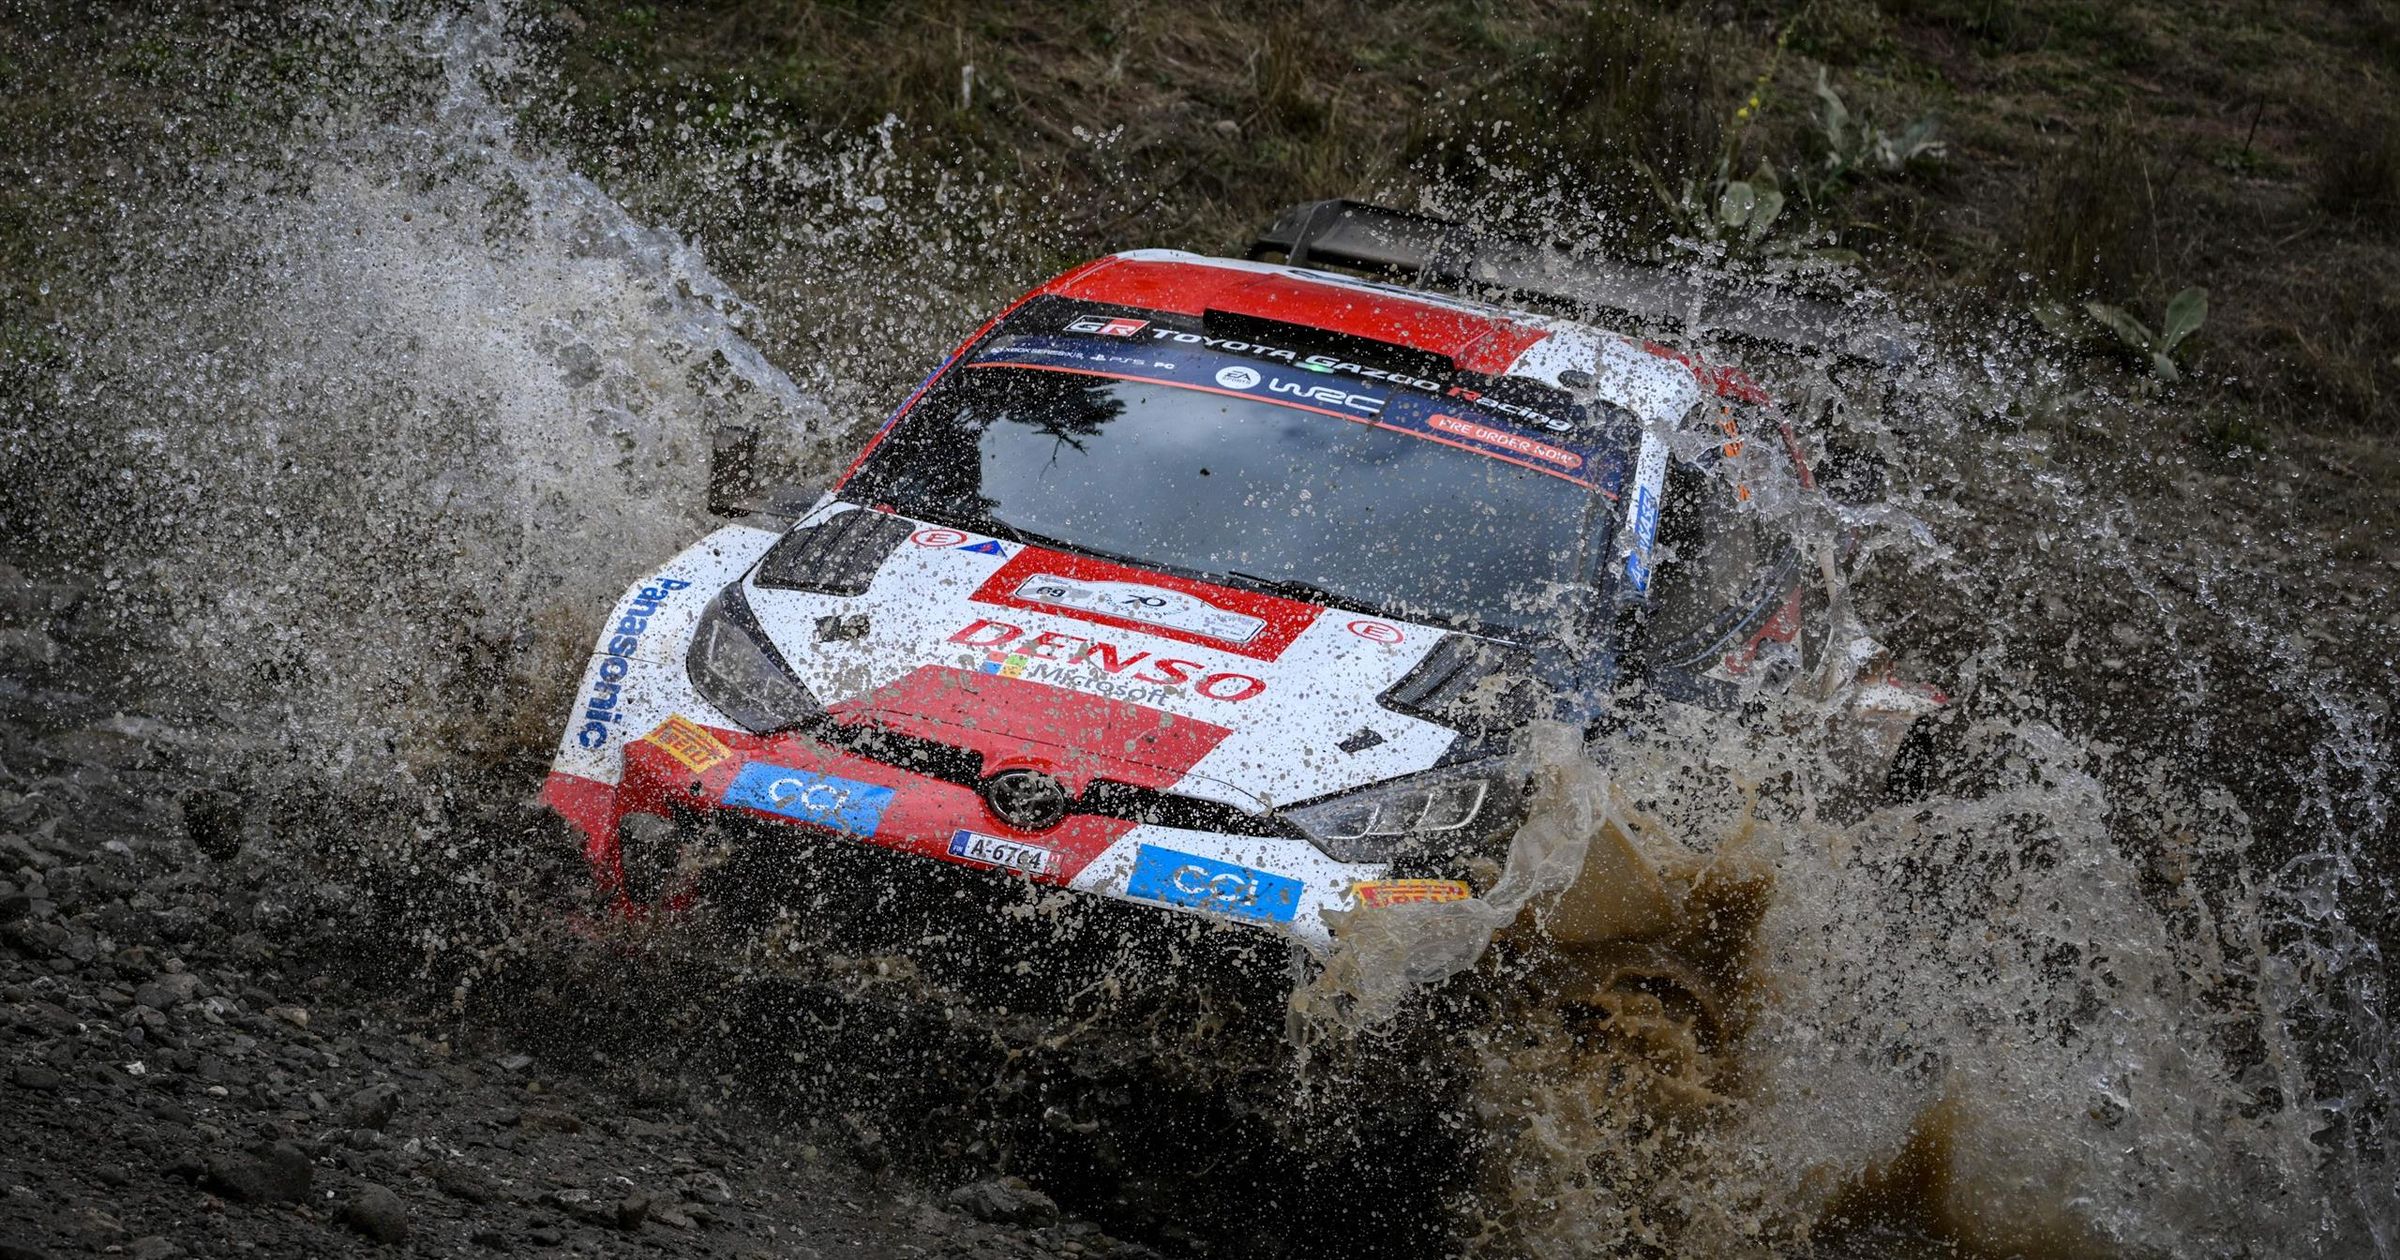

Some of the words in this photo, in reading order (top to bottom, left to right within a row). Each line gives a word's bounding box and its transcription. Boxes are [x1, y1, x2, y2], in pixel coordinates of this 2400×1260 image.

[1152, 328, 1297, 360] TOYOTA
[1305, 355, 1440, 392] GAZOO
[1154, 361, 1175, 369] PC
[1269, 377, 1388, 413] WRC
[1439, 419, 1473, 434] PRE
[1475, 427, 1531, 451] ORDER
[578, 576, 693, 750] Panasonic
[946, 618, 1270, 701] DENSO
[1030, 661, 1172, 707] Microsoft
